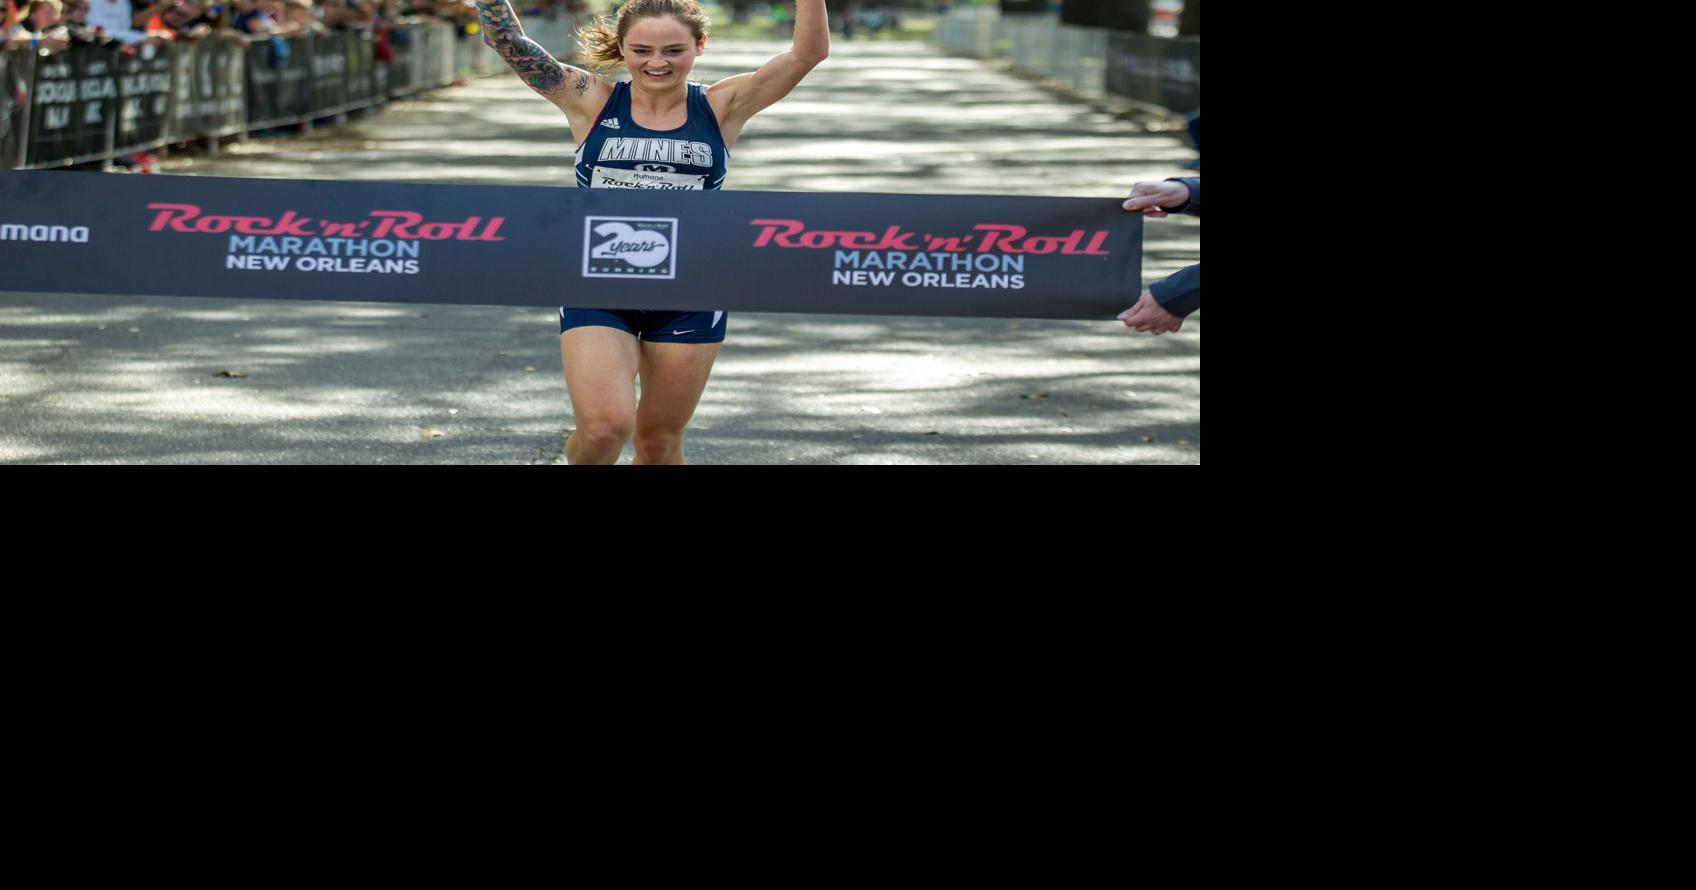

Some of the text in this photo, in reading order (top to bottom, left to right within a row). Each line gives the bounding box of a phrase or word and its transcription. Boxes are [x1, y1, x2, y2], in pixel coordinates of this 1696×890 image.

[598, 137, 713, 168] MINES
[0, 224, 90, 243] mana
[229, 235, 420, 258] MARATHON
[600, 240, 665, 256] years
[226, 255, 420, 275] NEW ORLEANS
[834, 250, 1025, 273] MARATHON
[832, 270, 1025, 290] NEW ORLEANS
